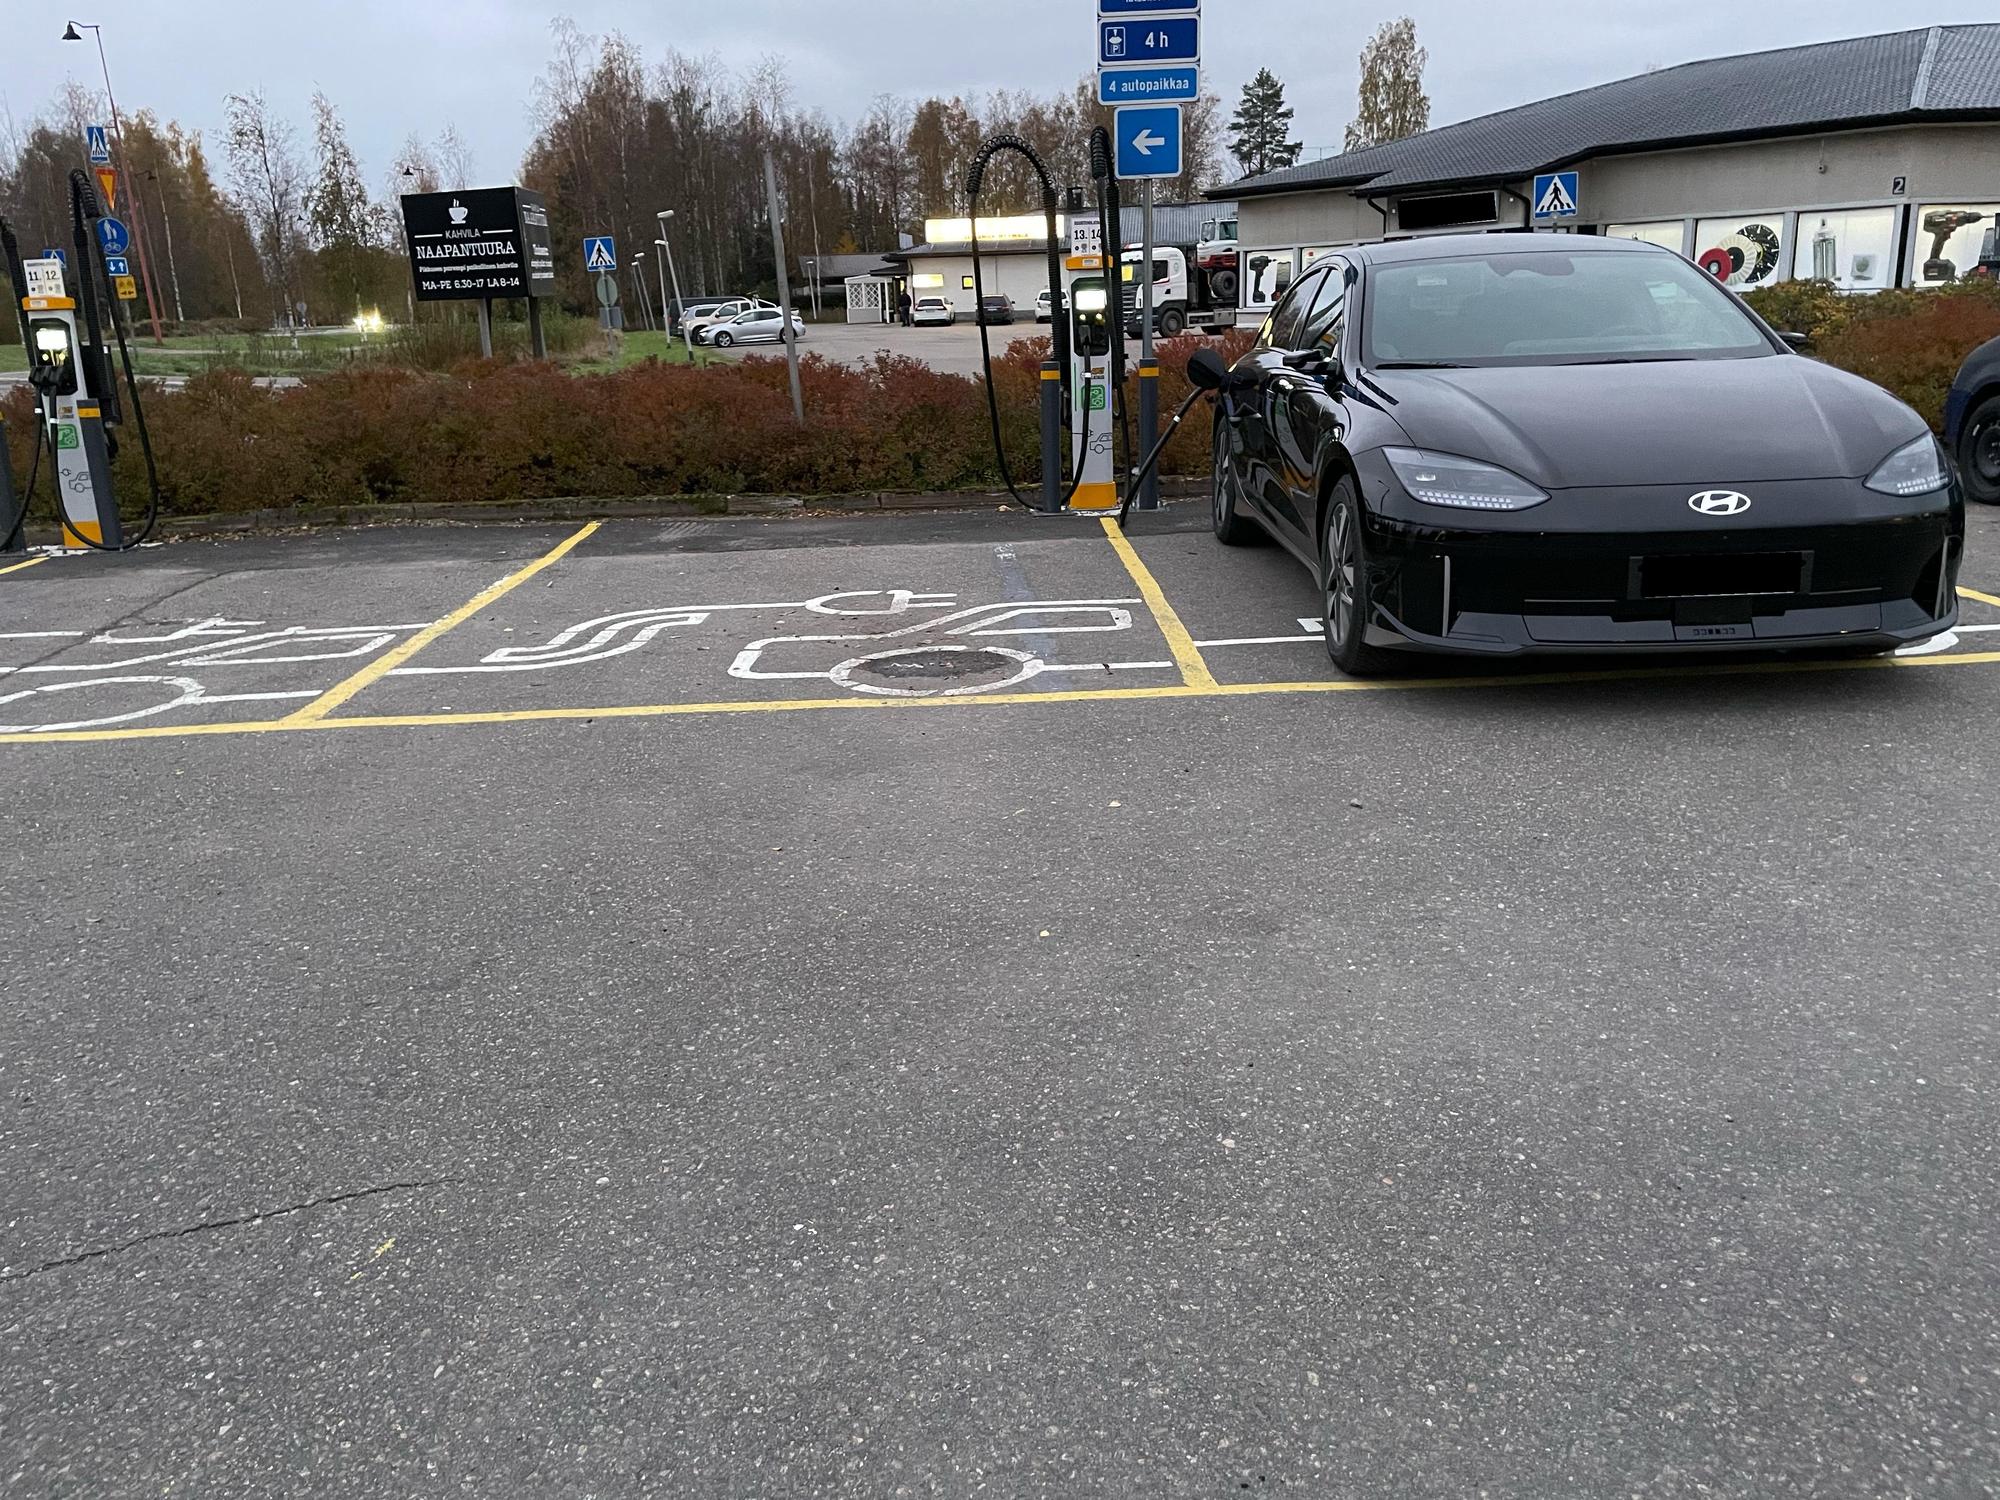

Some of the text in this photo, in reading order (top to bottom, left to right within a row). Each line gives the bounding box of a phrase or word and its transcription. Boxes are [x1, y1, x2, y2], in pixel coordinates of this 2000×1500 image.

[1145, 31, 1169, 48] 4 h
[1109, 77, 1189, 93] 4 autopaikkaa
[1894, 179, 1903, 193] 2
[445, 228, 481, 239] KAHVILA
[1074, 229, 1088, 240] 13.
[415, 241, 516, 259] NAAPANTUURA
[422, 277, 520, 290] MA-PE 6.30-17 LA 8-14
